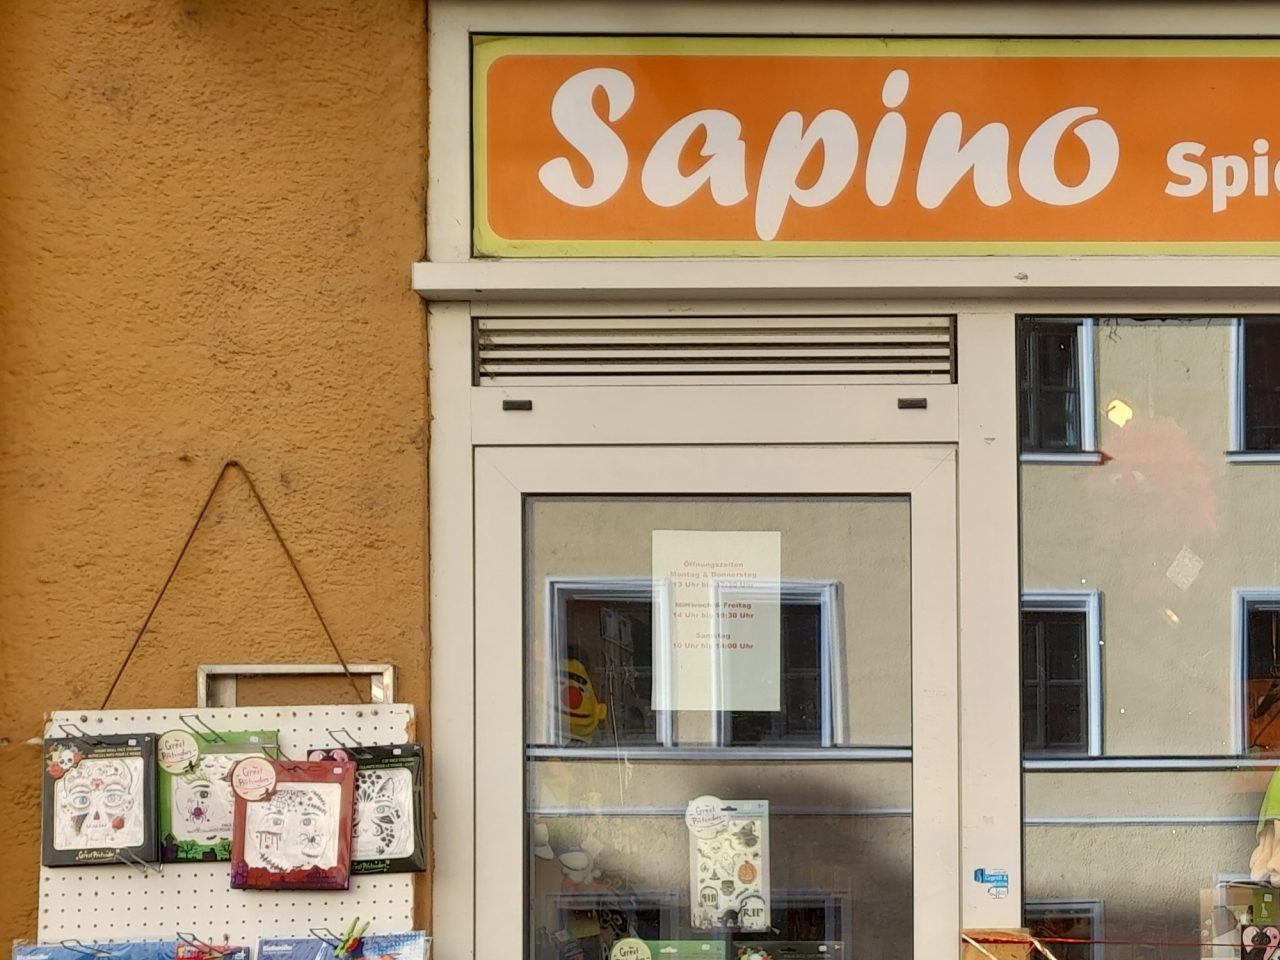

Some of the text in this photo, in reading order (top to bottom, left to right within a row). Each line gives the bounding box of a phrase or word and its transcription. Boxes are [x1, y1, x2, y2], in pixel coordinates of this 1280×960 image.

[538, 67, 1120, 242] Sapino
[723, 602, 752, 610] Freitag
[743, 908, 763, 917] RIP
[620, 947, 639, 957] Great
